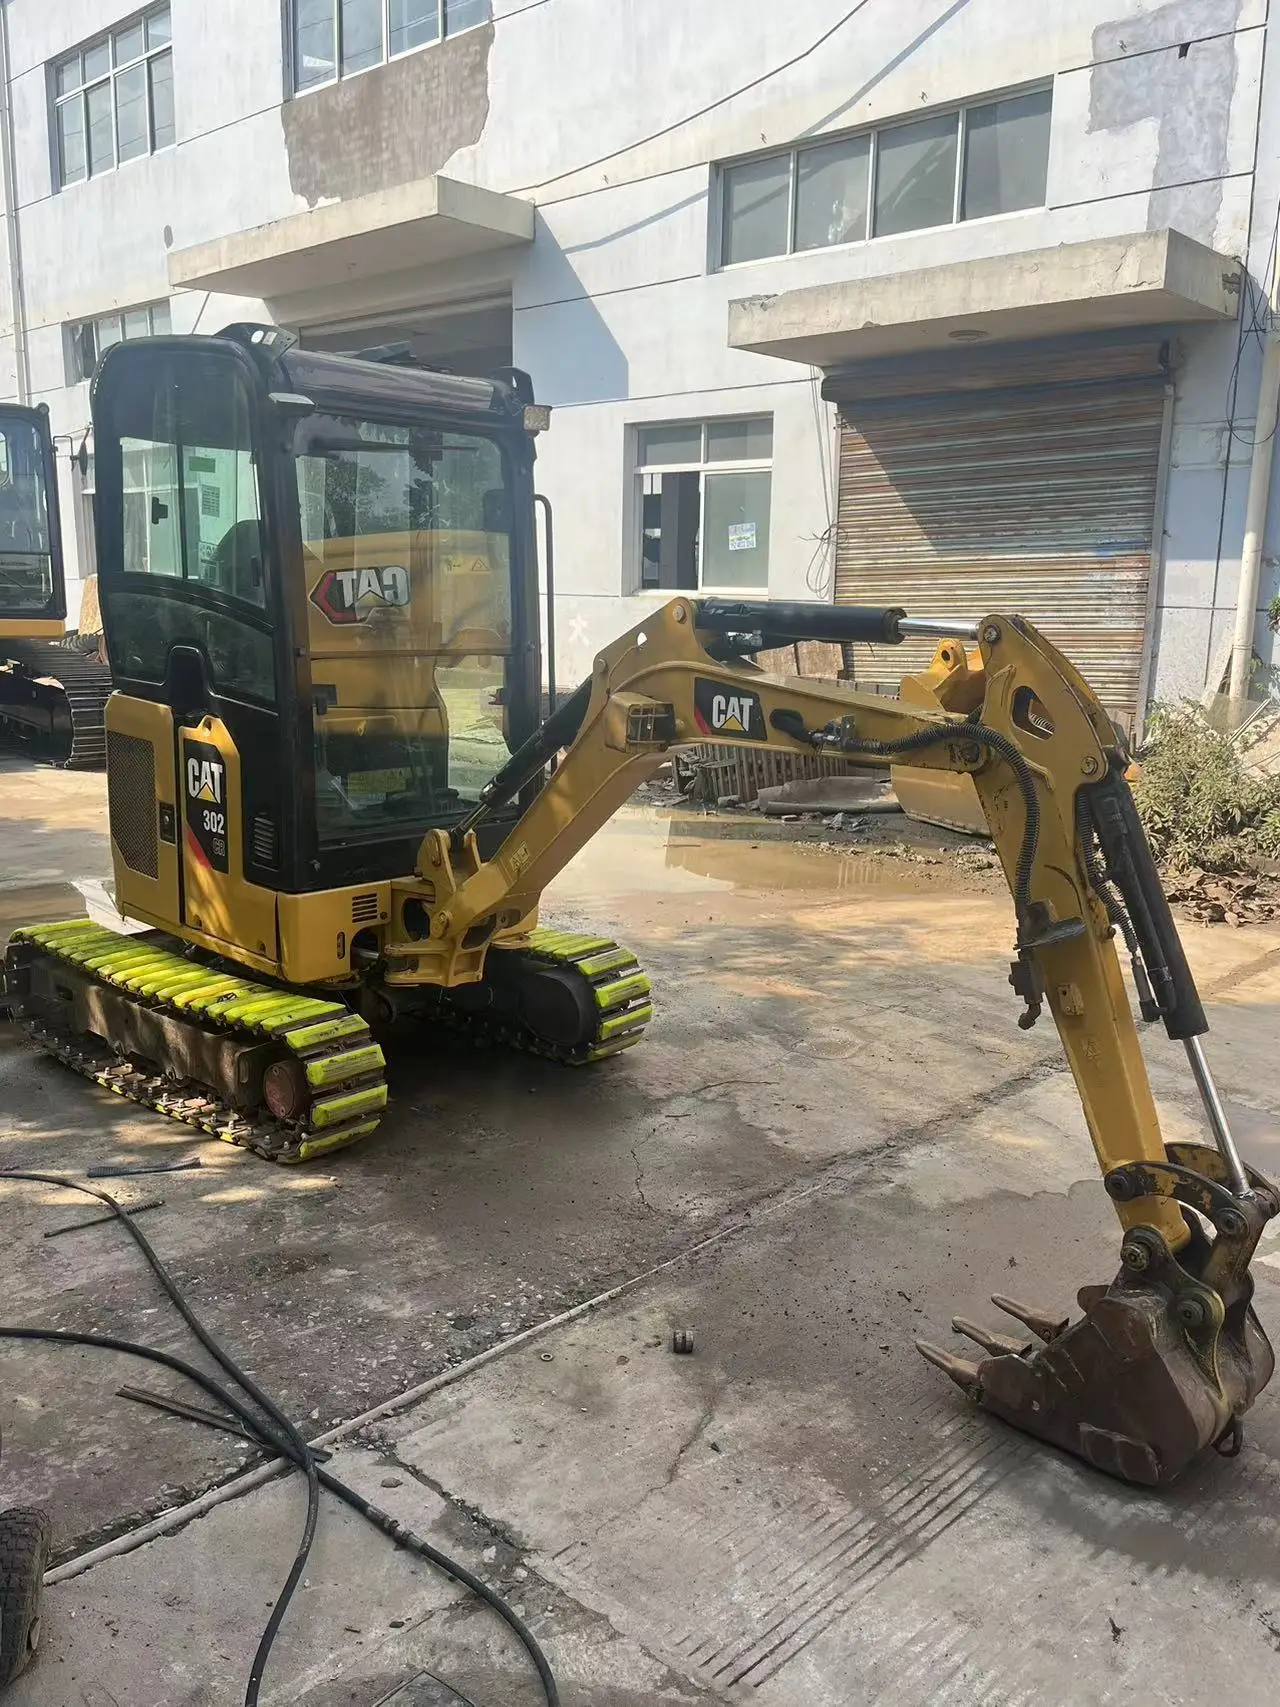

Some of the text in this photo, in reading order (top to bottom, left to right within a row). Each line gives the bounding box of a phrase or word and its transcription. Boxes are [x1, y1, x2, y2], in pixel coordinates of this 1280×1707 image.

[712, 694, 754, 732] CAT
[187, 757, 223, 804] CAT
[203, 809, 225, 835] 302
